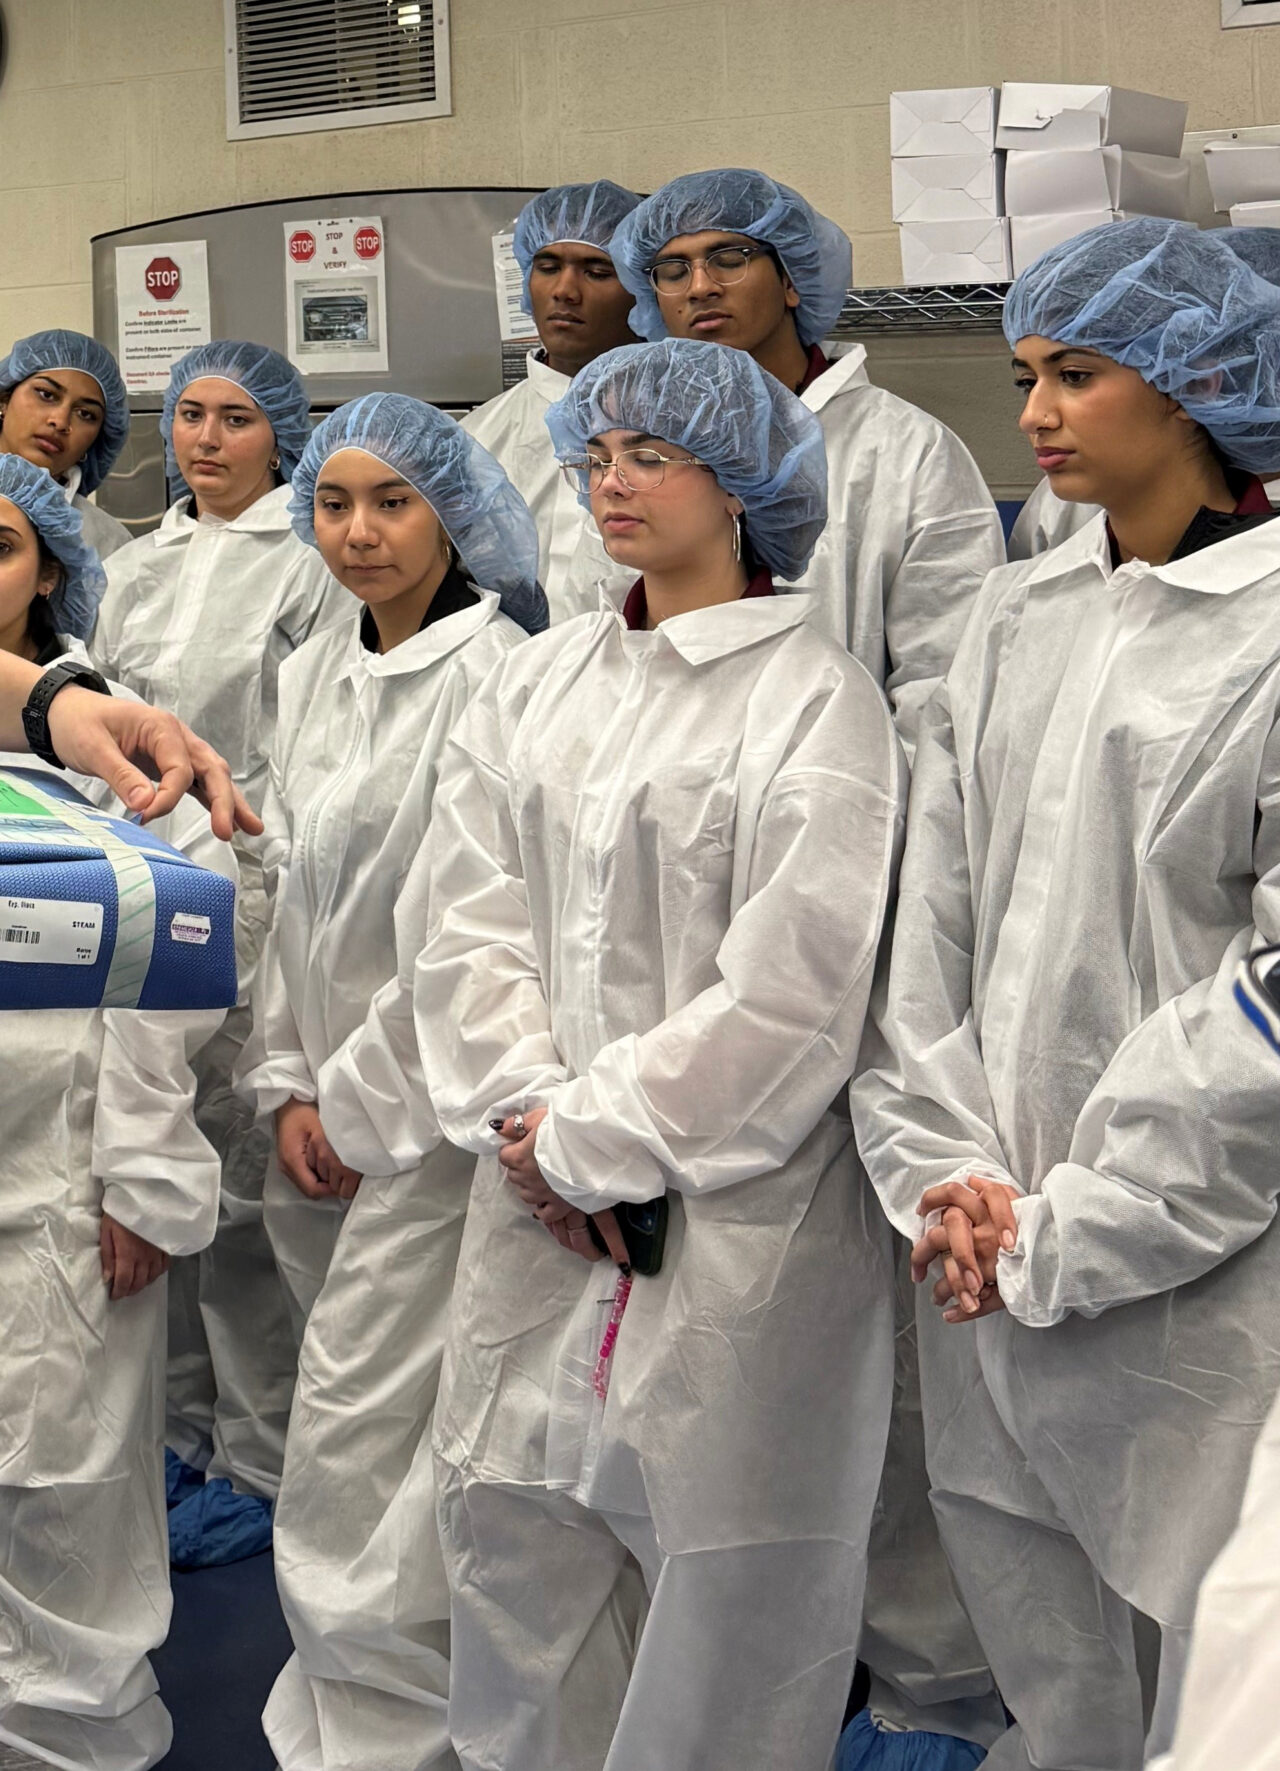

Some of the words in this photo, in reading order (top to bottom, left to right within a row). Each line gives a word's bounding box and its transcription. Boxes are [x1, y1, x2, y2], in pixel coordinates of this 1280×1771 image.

[325, 232, 343, 240] STOP
[291, 240, 313, 253] STOP
[356, 236, 379, 250] STOP
[323, 260, 347, 269] VERIFY
[147, 270, 179, 288] STOP
[72, 921, 95, 929] STEAM
